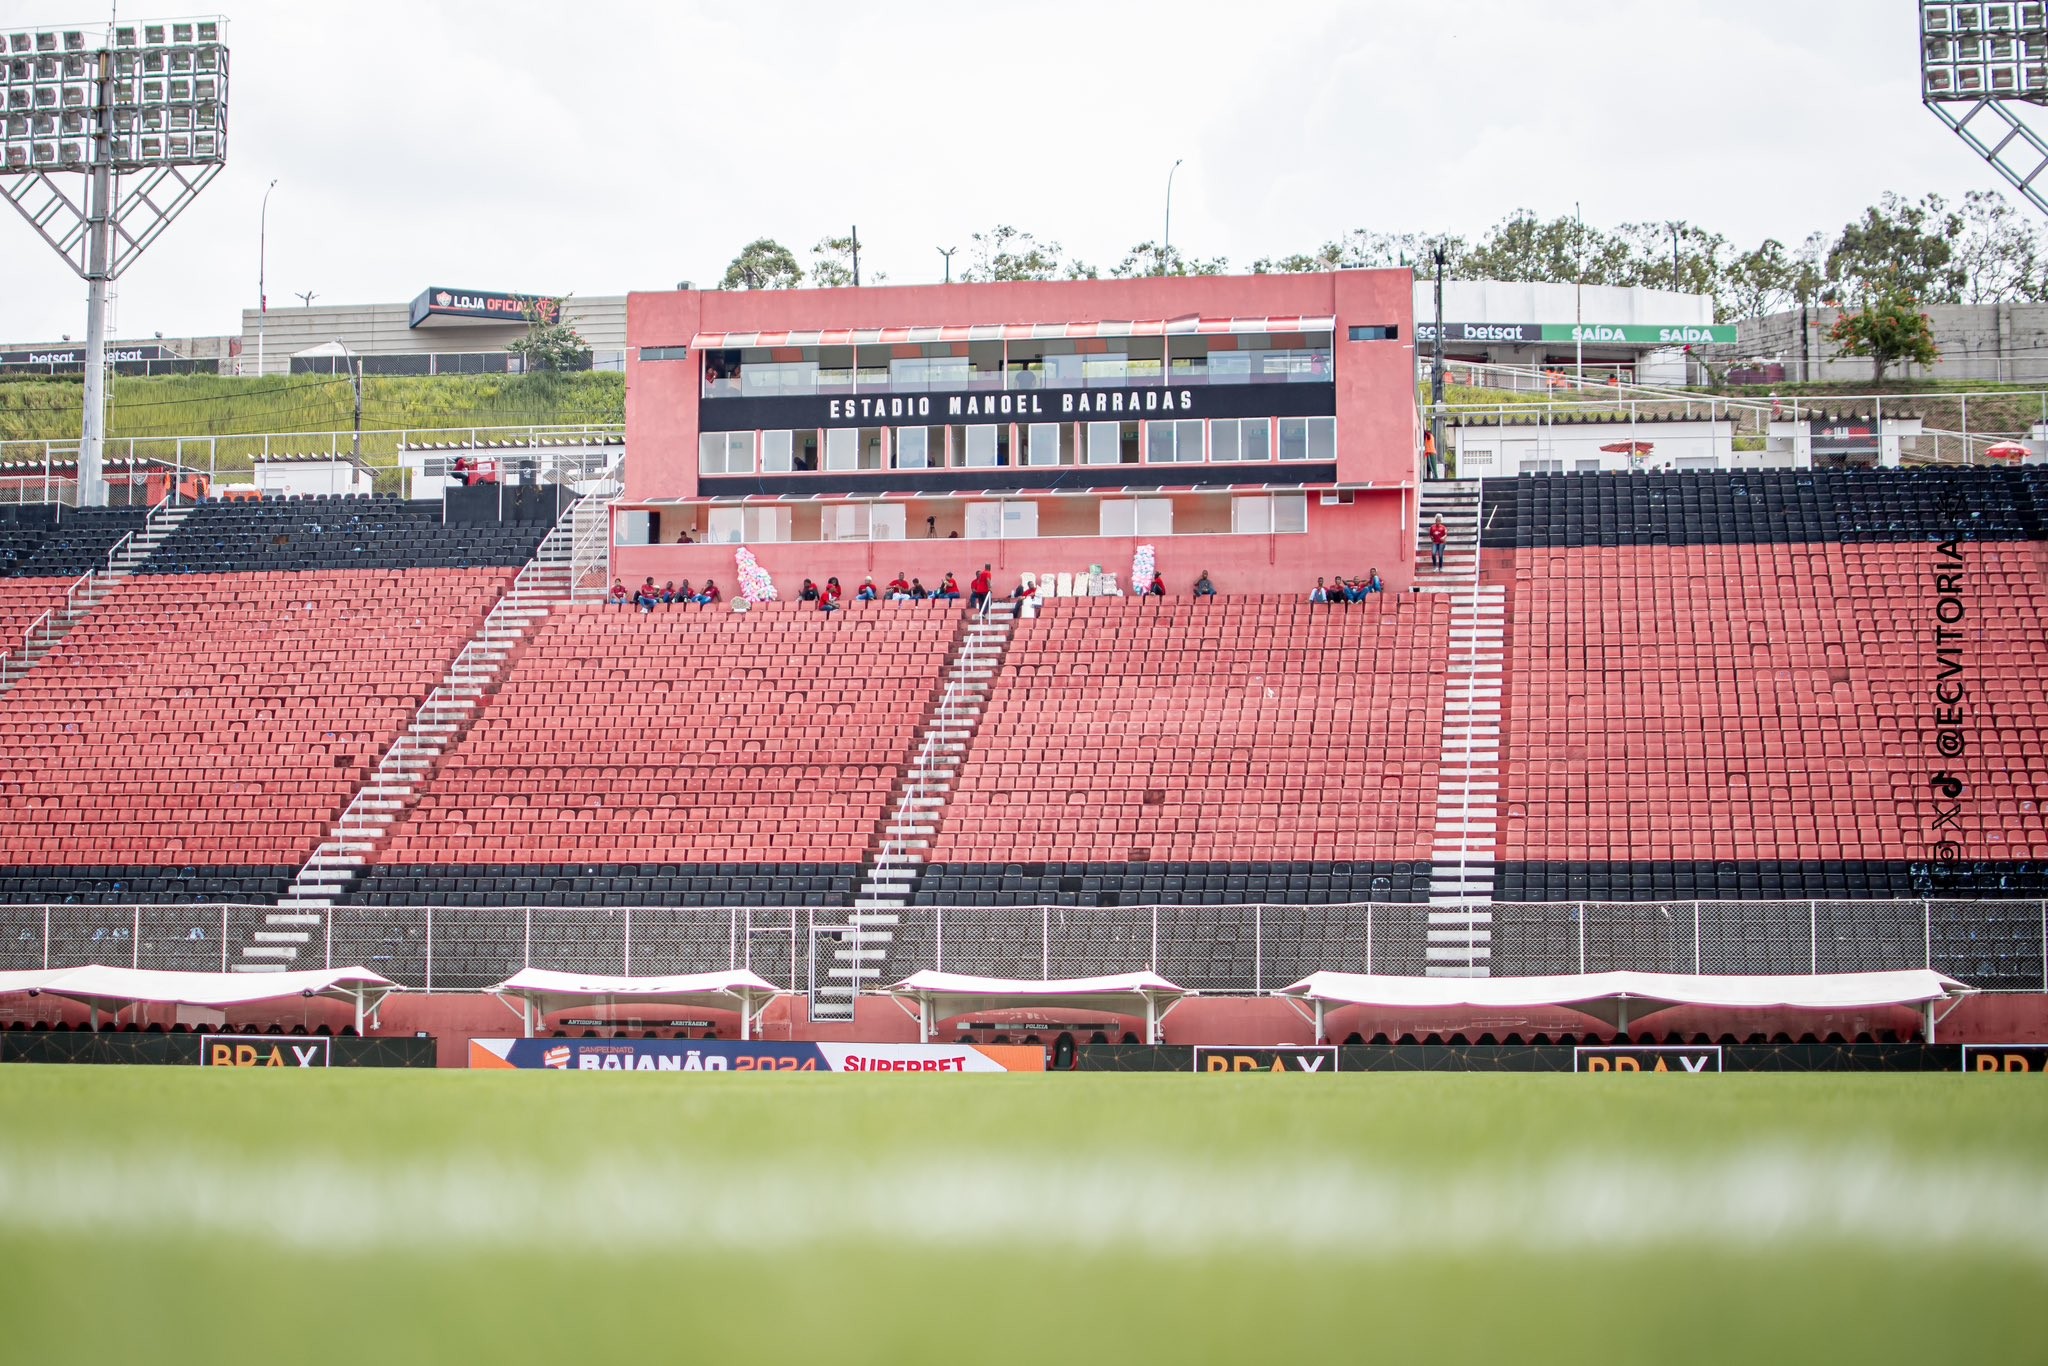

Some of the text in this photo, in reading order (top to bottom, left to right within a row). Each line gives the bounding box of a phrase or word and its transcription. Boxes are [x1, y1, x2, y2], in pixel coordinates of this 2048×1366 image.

[454, 295, 485, 309] LOJA
[1464, 324, 1522, 339] betsat
[1572, 325, 1626, 341] SAÍDA
[1659, 326, 1713, 342] SAÍDA
[29, 352, 75, 363] betsat
[103, 349, 142, 361] etsat
[830, 390, 1192, 418] ESTADIO MANOEL BARRADAS
[579, 1046, 634, 1054] CAMPEONATO
[579, 1050, 816, 1071] BAIANÃO 2024
